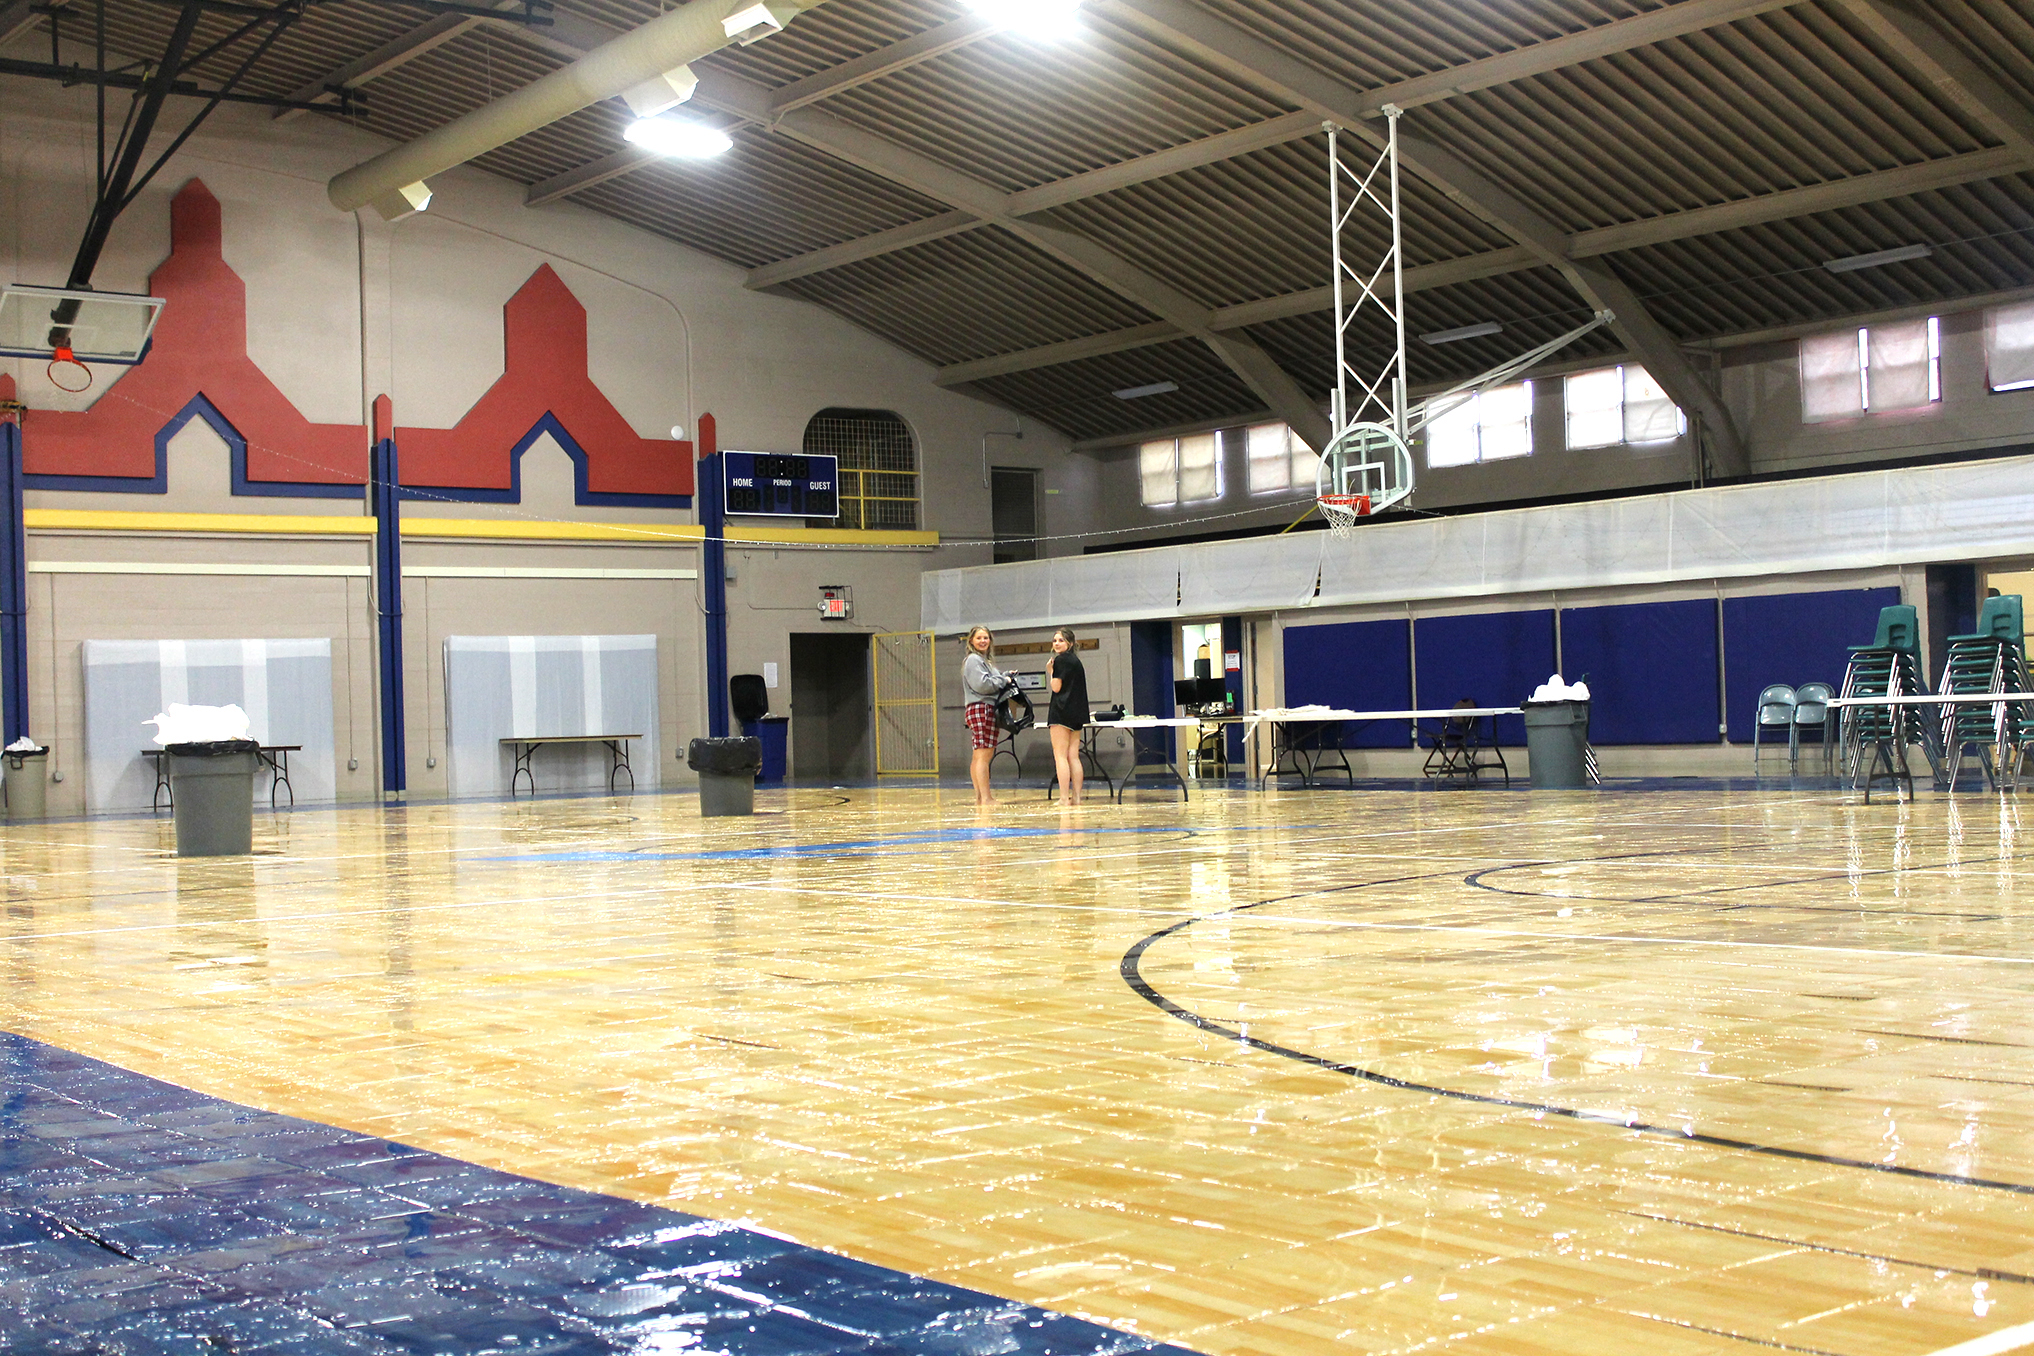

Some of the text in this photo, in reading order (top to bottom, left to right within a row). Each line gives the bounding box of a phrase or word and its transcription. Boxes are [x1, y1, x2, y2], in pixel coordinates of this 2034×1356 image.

[732, 478, 831, 490] HOME PERIOD GUEST
